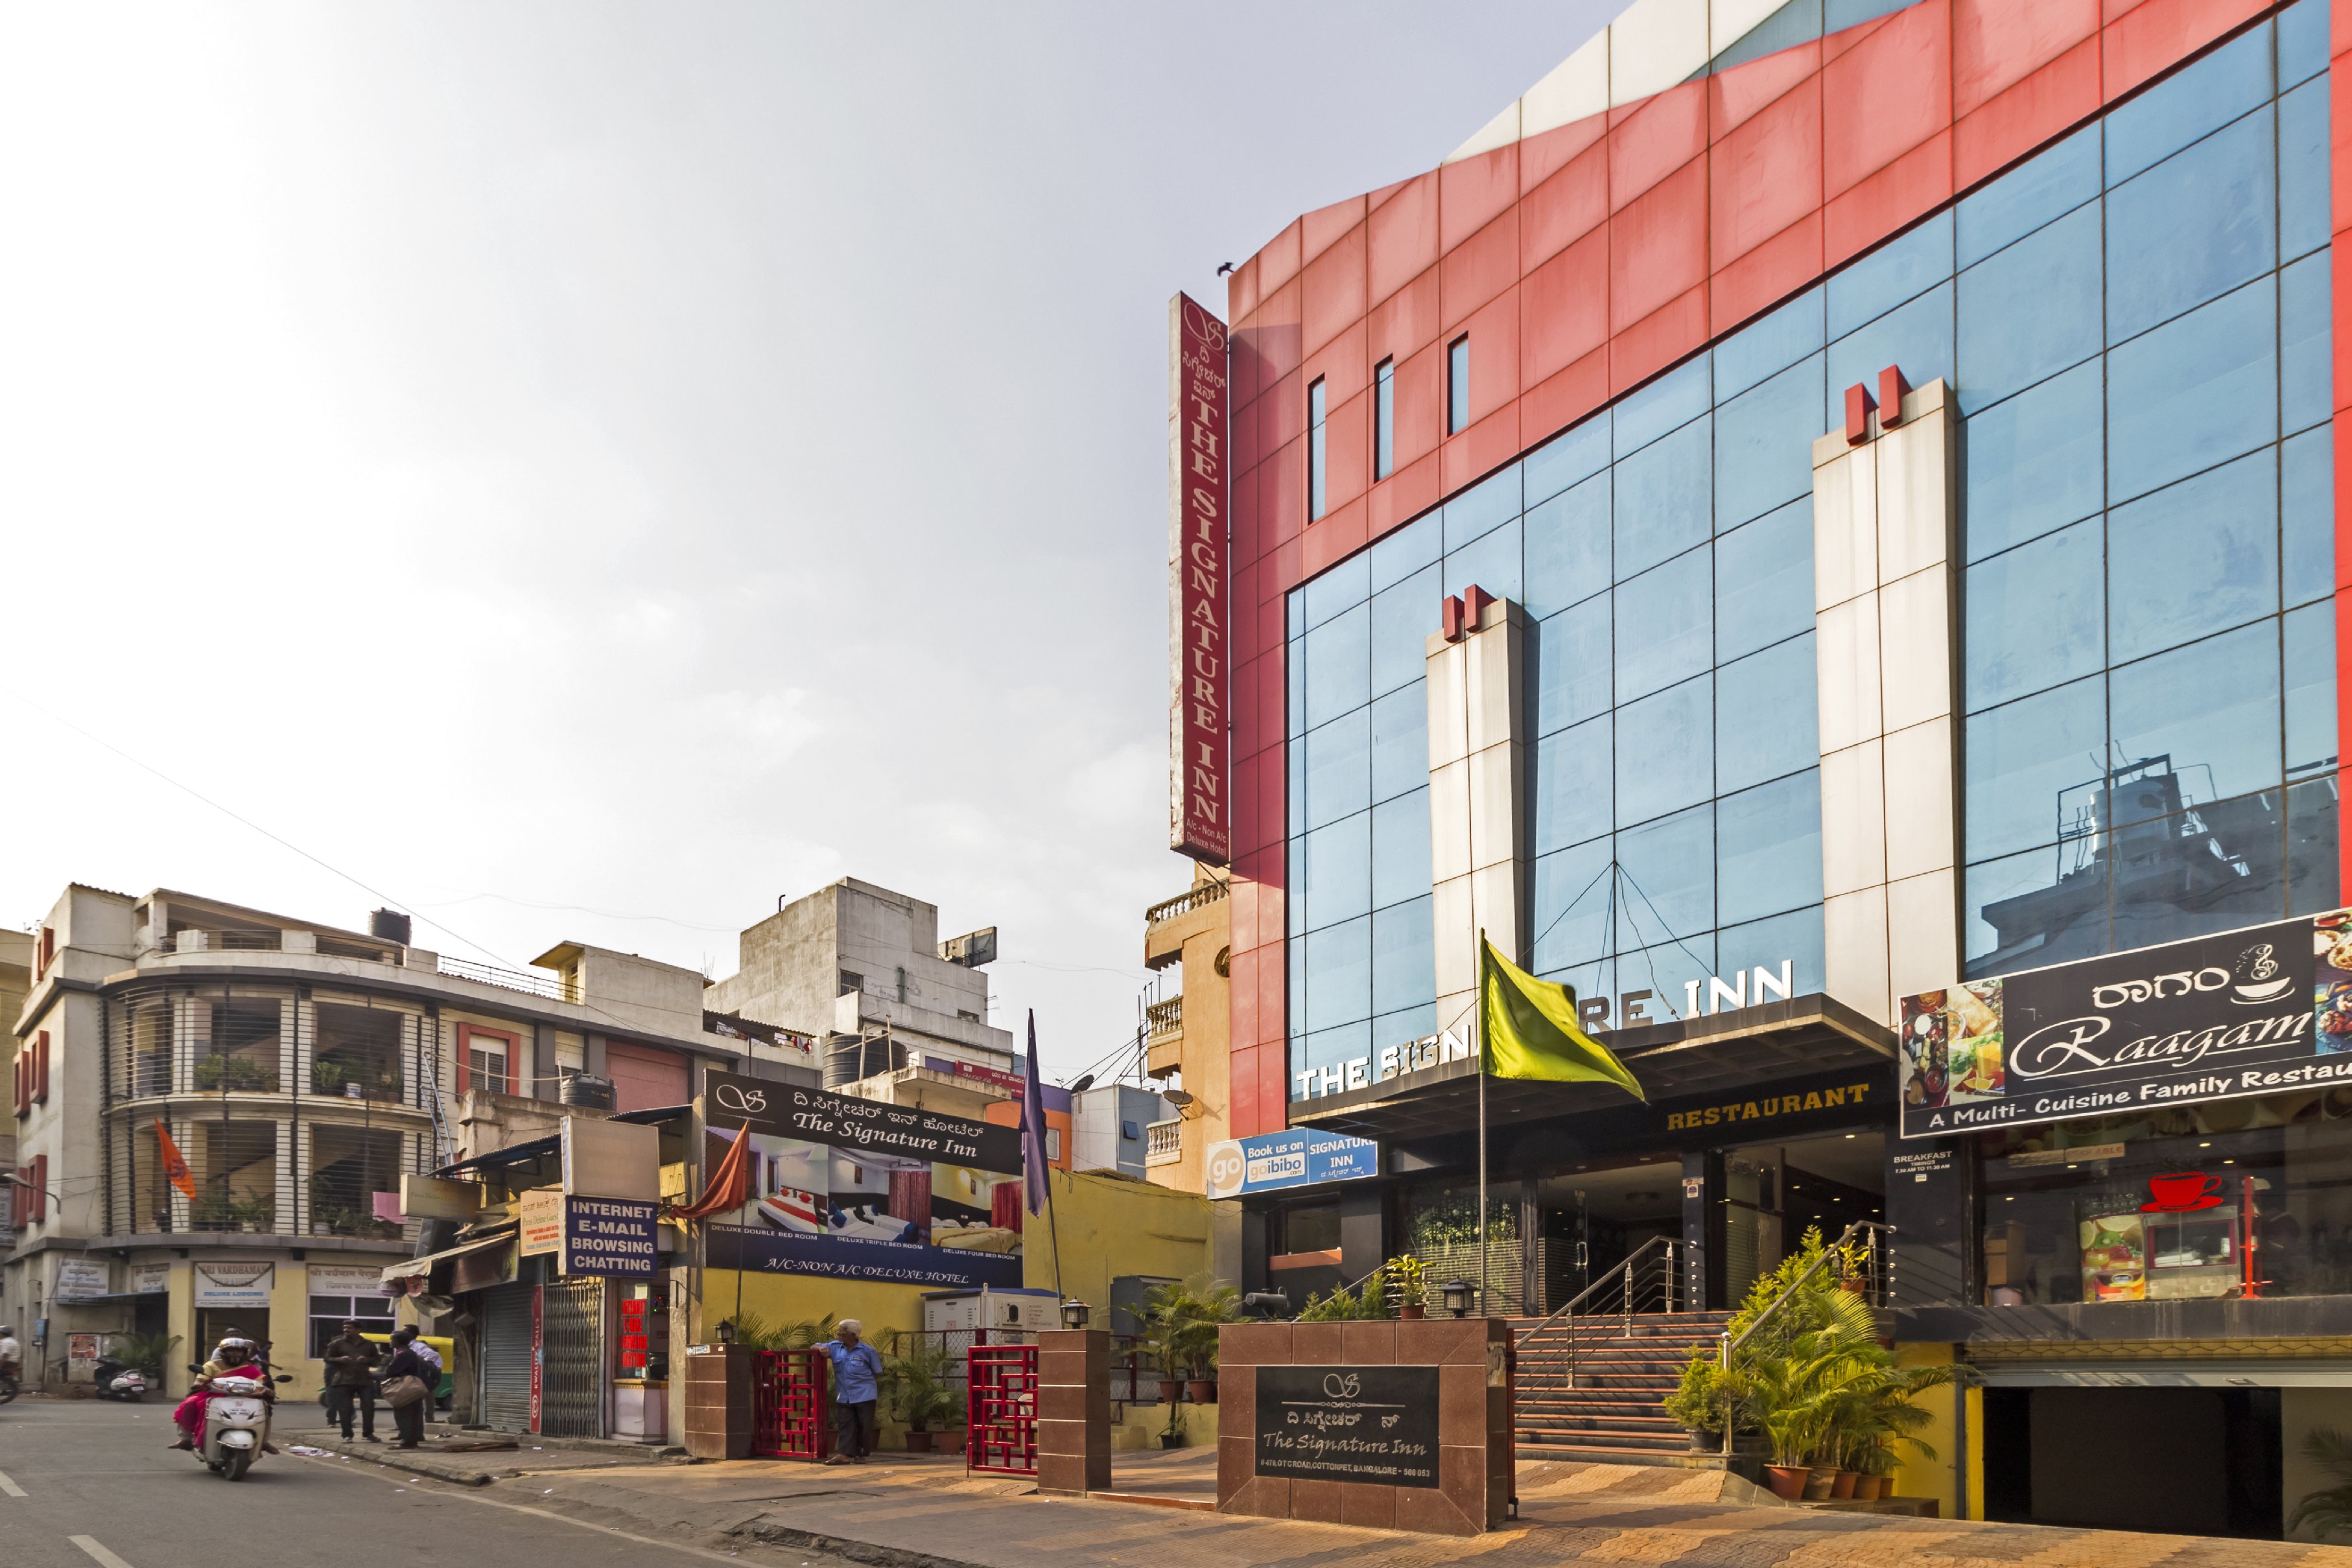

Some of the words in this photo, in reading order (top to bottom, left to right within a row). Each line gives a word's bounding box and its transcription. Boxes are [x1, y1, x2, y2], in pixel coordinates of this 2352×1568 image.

[1191, 393, 1218, 485] THE
[1191, 487, 1219, 734] SIGNATURE
[1193, 741, 1219, 824] INN
[1186, 832, 1208, 849] Deluxe
[1210, 842, 1227, 857] Hotel
[1202, 825, 1214, 839] Non
[1216, 832, 1227, 843] A/c
[1297, 1057, 1370, 1100] THE
[1685, 959, 1793, 1019] INN
[2010, 1011, 2314, 1077] Raagam
[1667, 1083, 1869, 1130] RESTAURANT
[1929, 1114, 1945, 1128] A
[1953, 1104, 2027, 1125] Multi-
[2034, 1091, 2131, 1114] Cuisine
[2140, 1076, 2233, 1100] Family
[793, 1112, 834, 1132] The
[838, 1121, 938, 1150] Signature
[943, 1139, 978, 1158] Inn
[1248, 1145, 1273, 1158] Book
[1275, 1143, 1288, 1153] us
[1290, 1141, 1304, 1151] on
[1330, 1154, 1353, 1168] INN
[1894, 1151, 1952, 1163] BREAKFAST
[1212, 1155, 1241, 1183] go
[1251, 1158, 1301, 1180] goibibo
[573, 1201, 653, 1219] INTERNET
[579, 1220, 647, 1235] E-MAIL
[572, 1237, 653, 1254] BROWSING
[574, 1256, 650, 1271] CHATTING
[833, 1264, 861, 1275] A/C
[864, 1266, 923, 1280] DELUXE
[925, 1272, 969, 1284] HOTEL
[1264, 1431, 1293, 1448] The
[1297, 1434, 1388, 1458] Signature
[1392, 1439, 1427, 1456] Inn
[1354, 1465, 1397, 1475] BANGALORE
